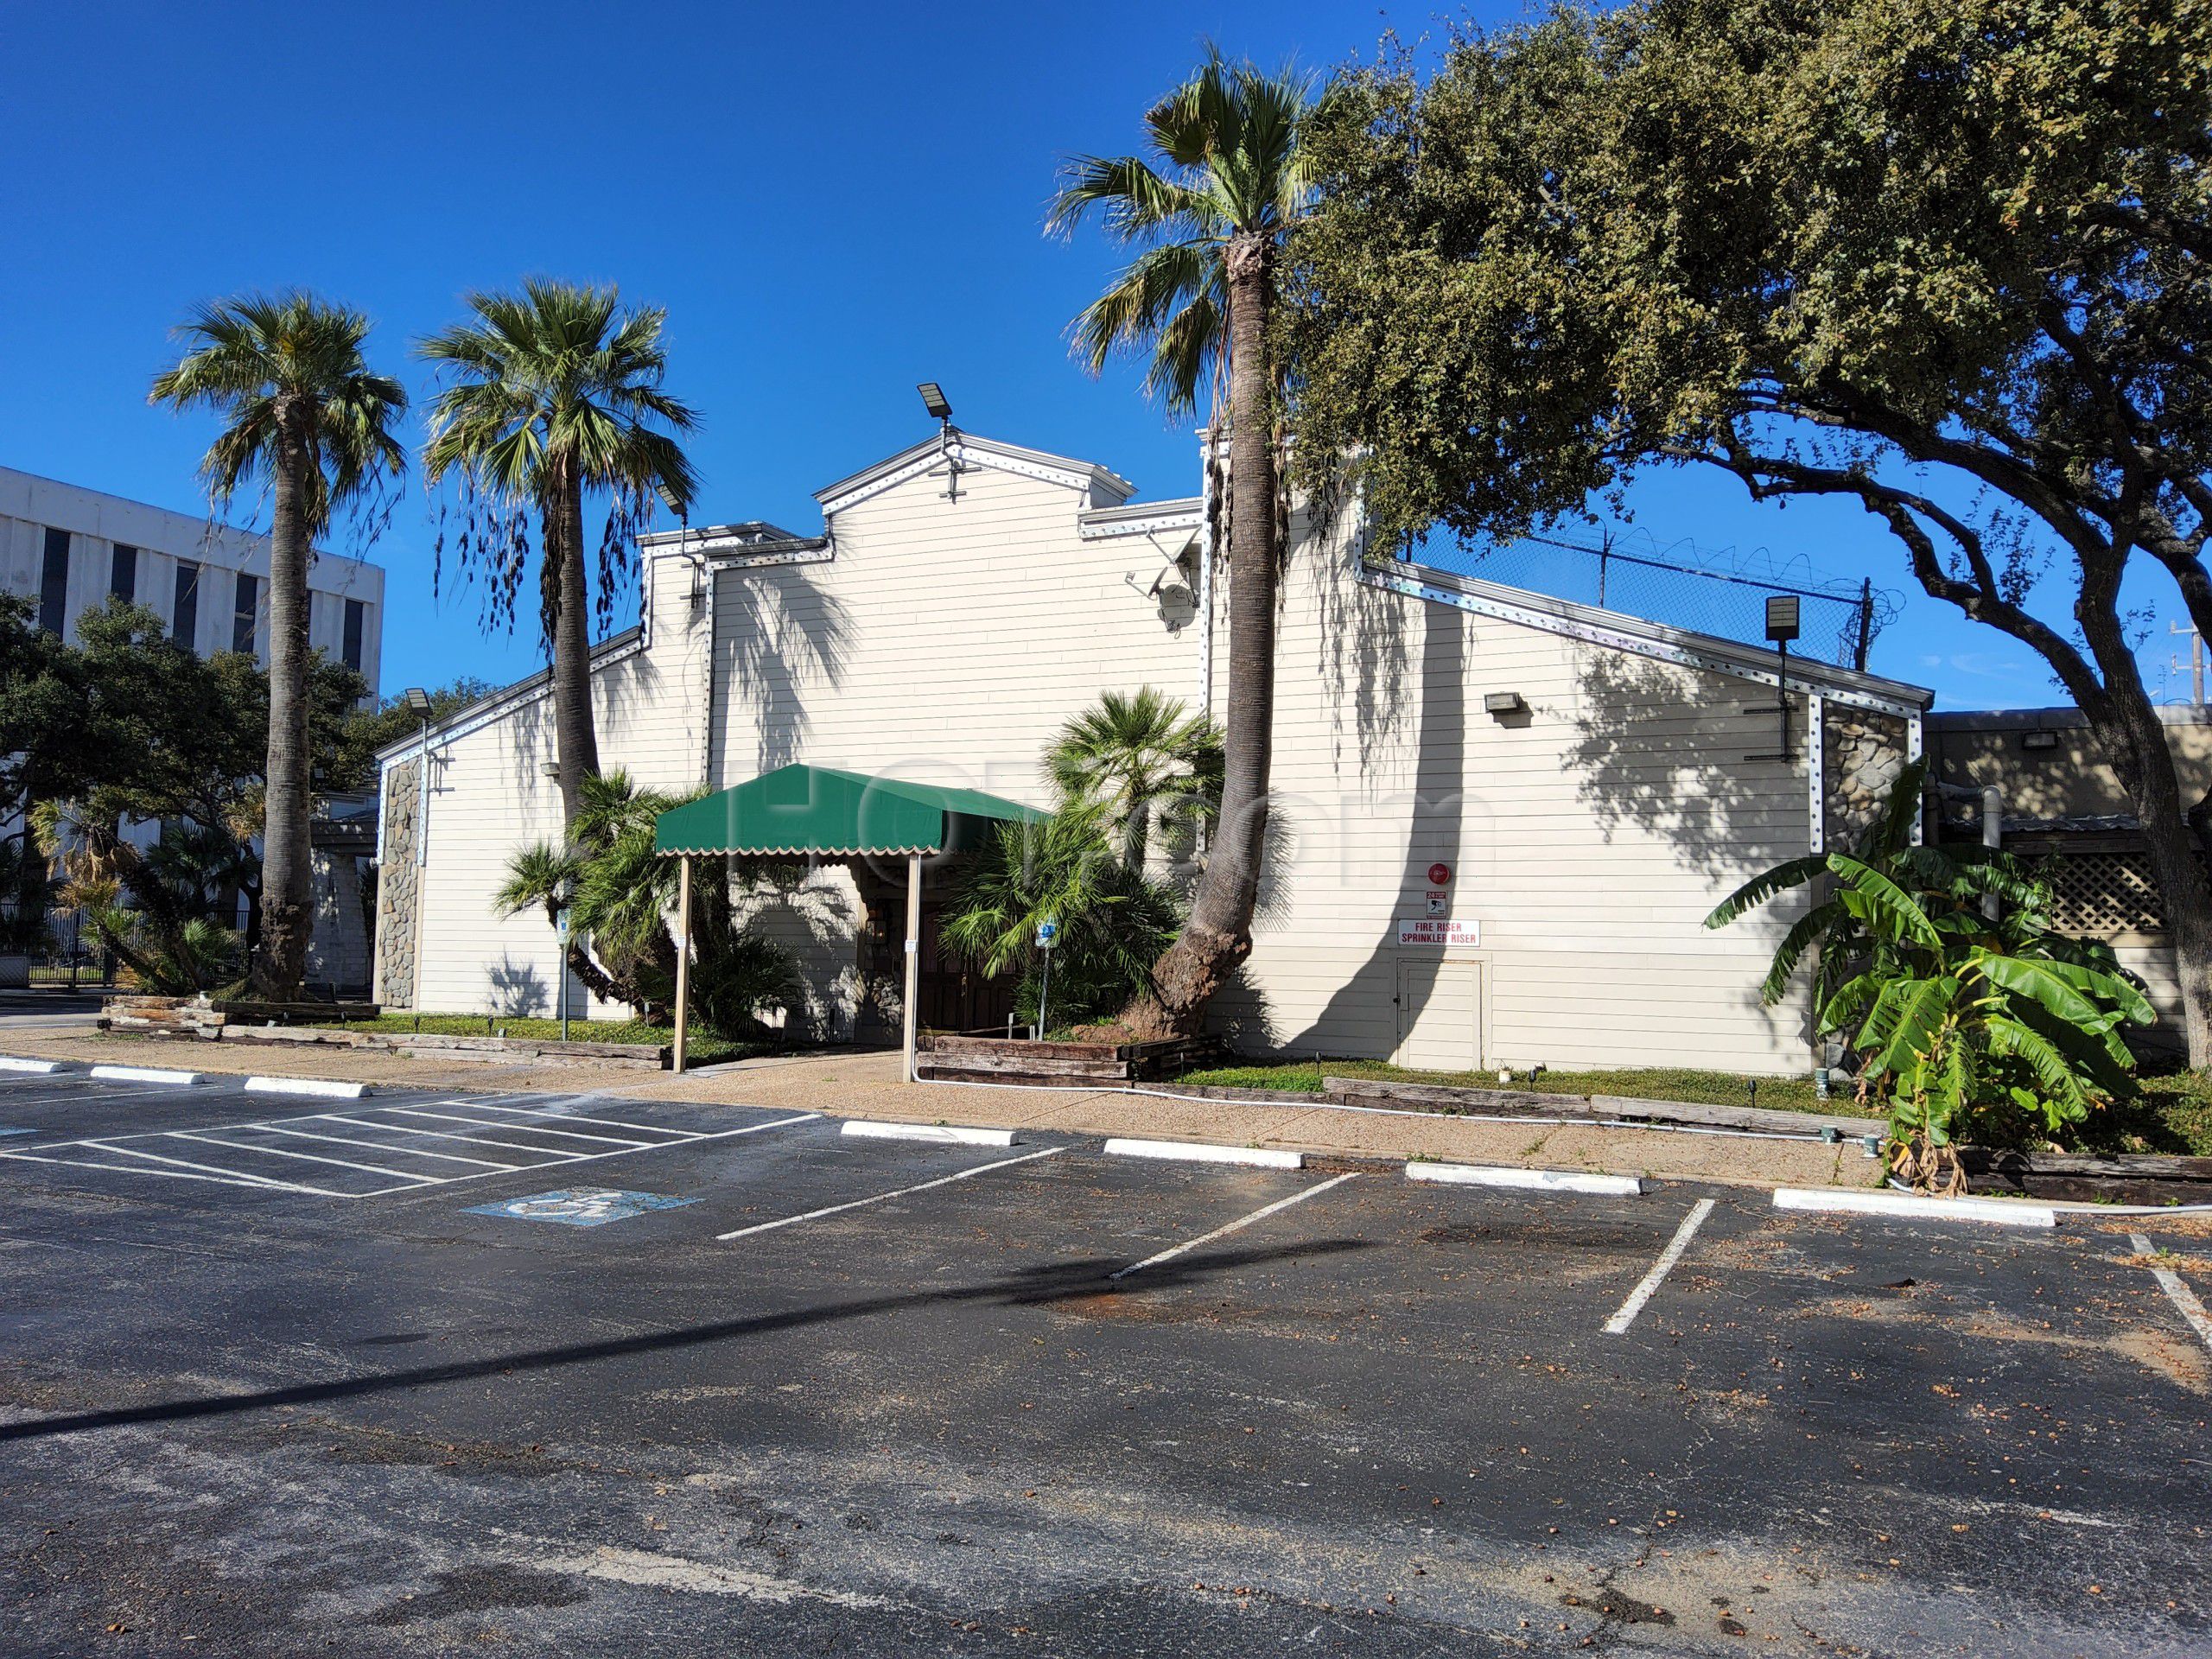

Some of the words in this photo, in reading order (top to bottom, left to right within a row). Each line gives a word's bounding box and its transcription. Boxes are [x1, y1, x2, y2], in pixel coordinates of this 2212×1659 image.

[1415, 922, 1433, 931] FIRE
[1437, 922, 1461, 932] RISER
[1402, 933, 1446, 943] SPRINKLER
[1451, 934, 1476, 944] RISER
